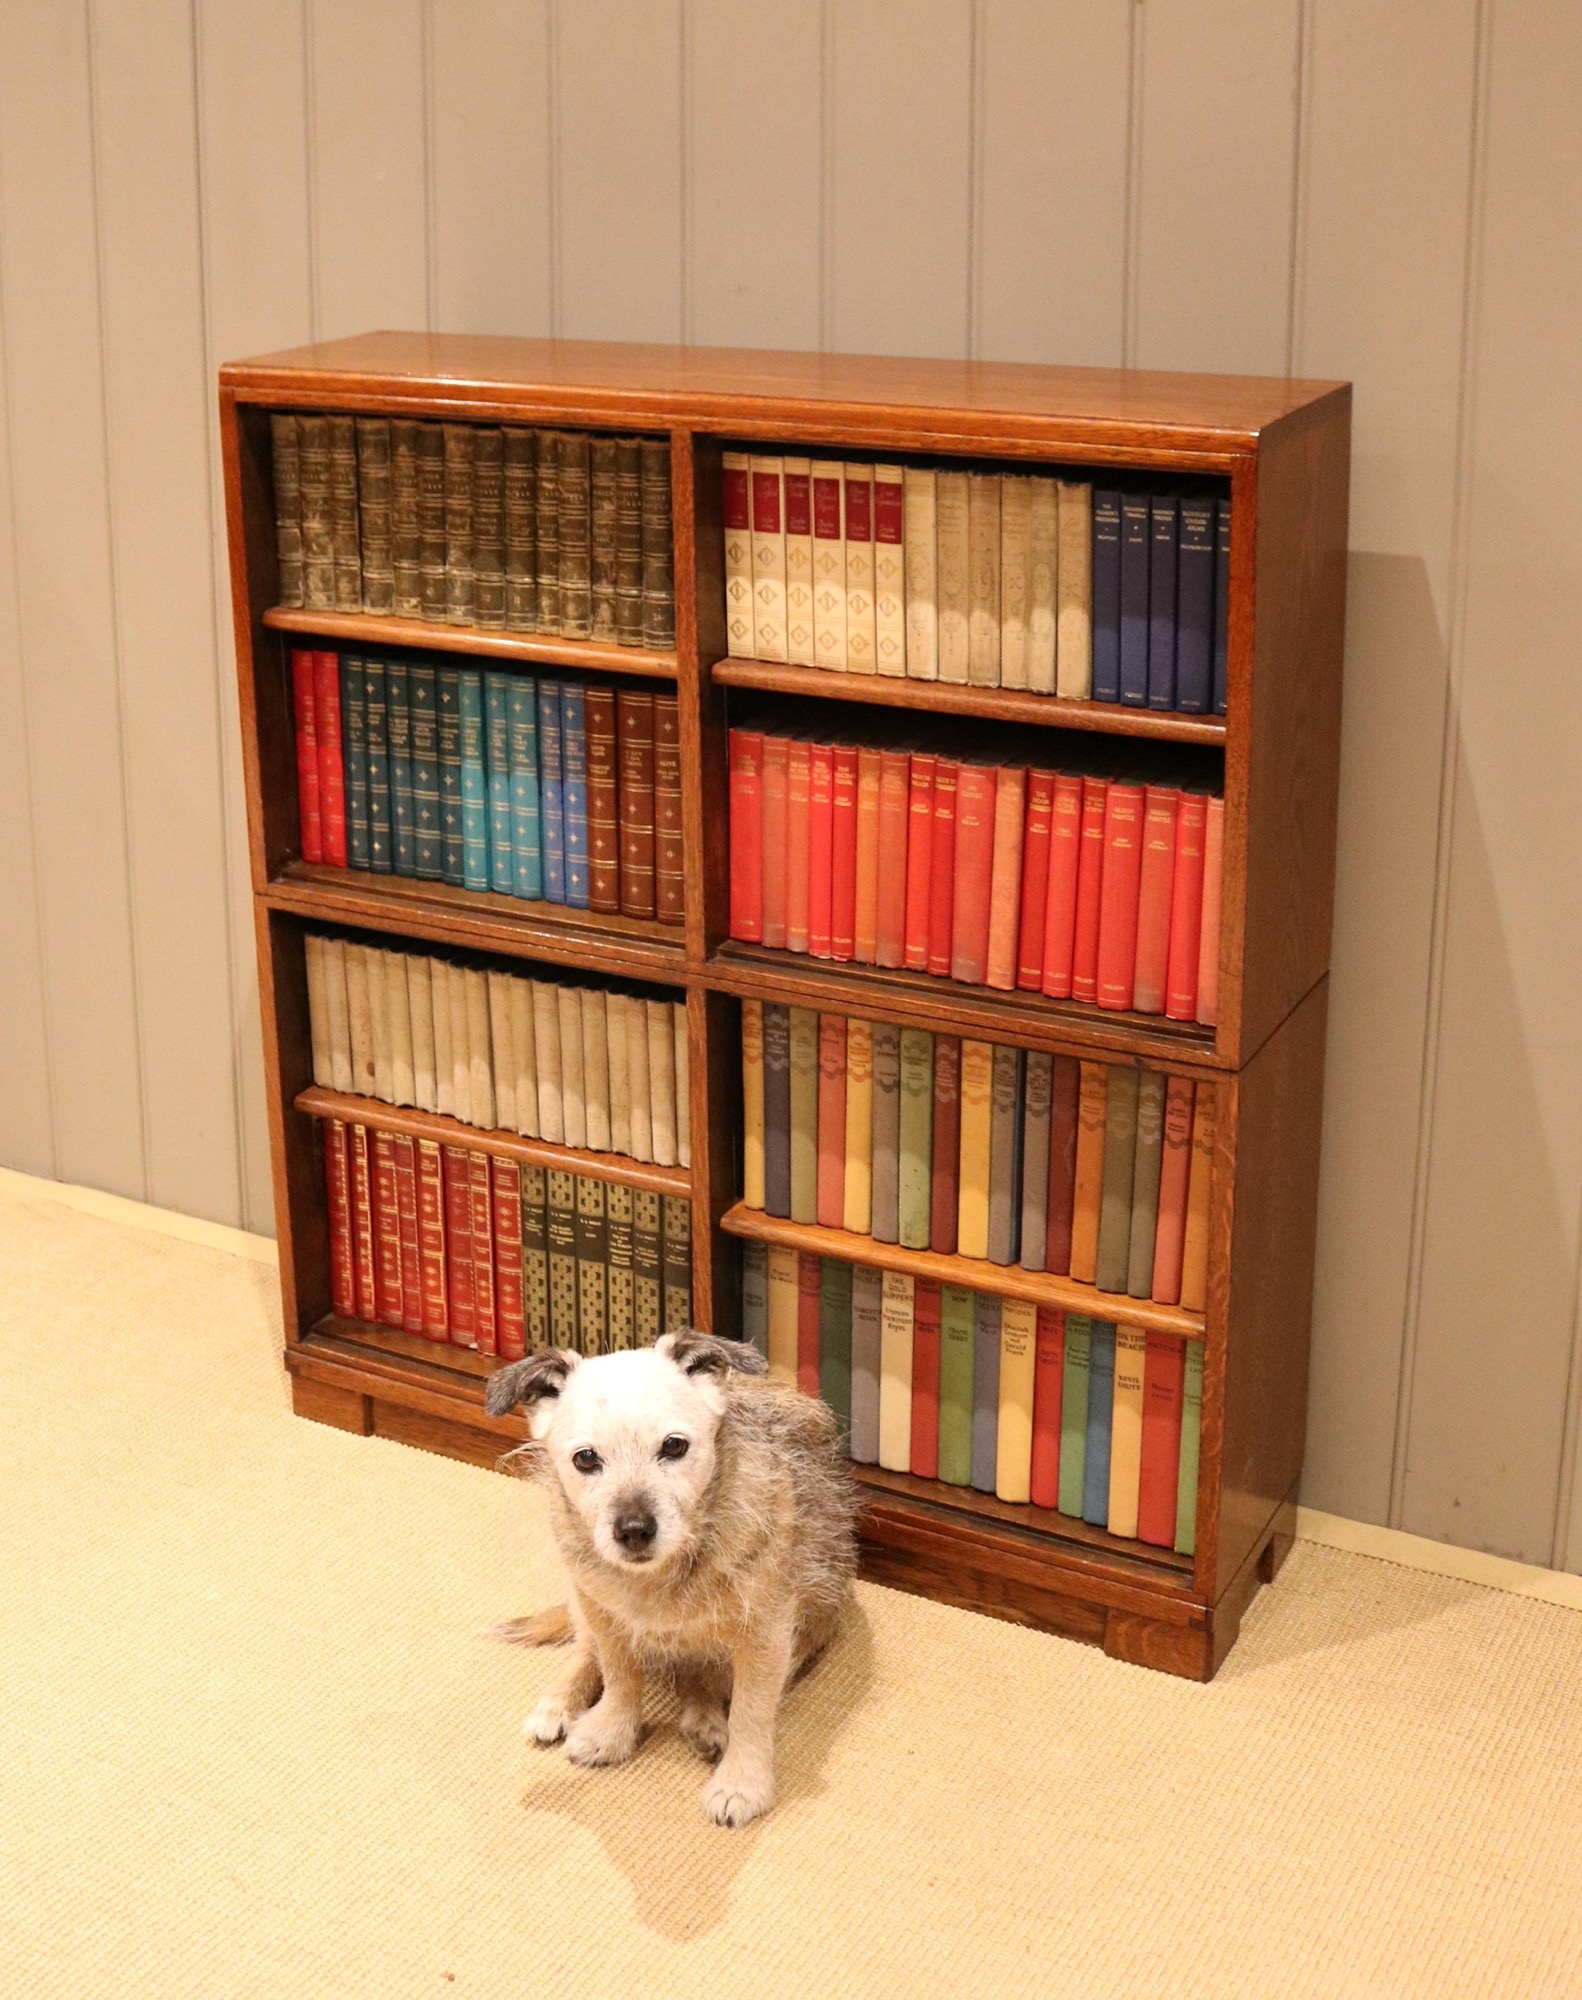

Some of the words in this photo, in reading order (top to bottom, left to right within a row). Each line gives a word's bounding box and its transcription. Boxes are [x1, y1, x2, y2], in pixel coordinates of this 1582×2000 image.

[891, 1277, 904, 1285] THE
[888, 1284, 907, 1293] GOLD
[1117, 1333, 1128, 1341] ON
[1117, 1342, 1145, 1351] BEACH
